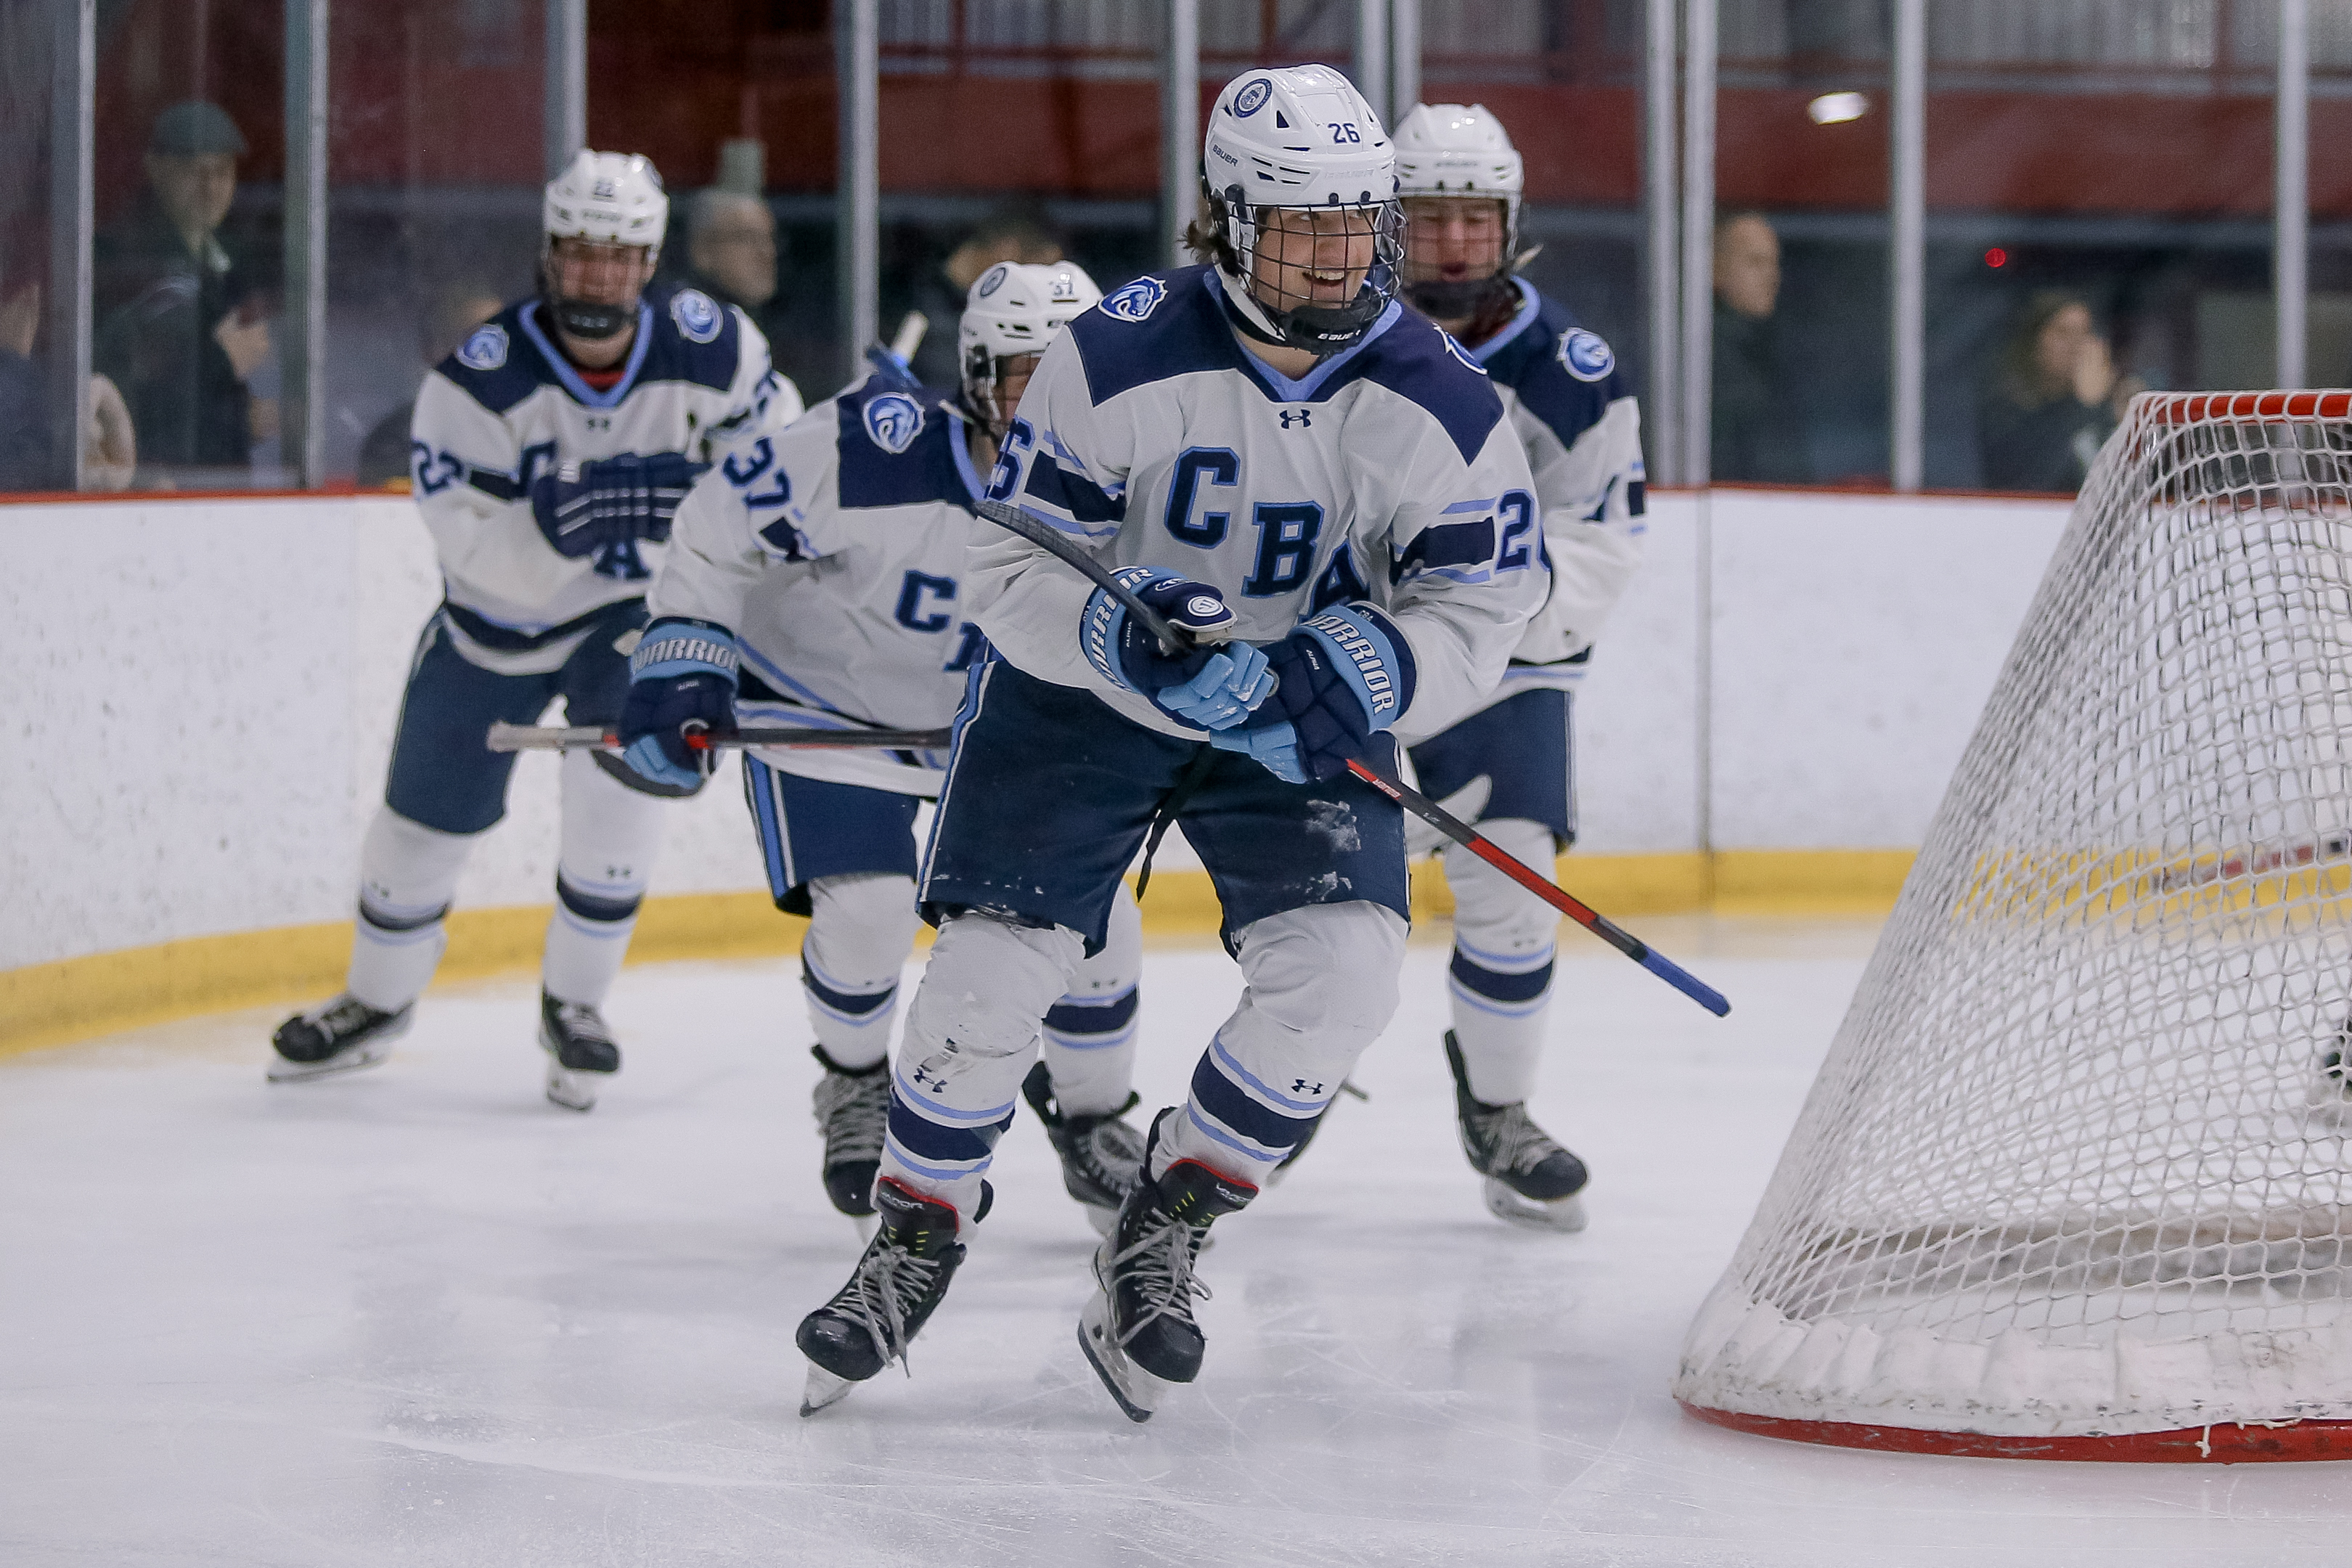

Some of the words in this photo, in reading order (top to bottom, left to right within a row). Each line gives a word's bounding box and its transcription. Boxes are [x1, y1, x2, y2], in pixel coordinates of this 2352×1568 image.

[1212, 144, 1238, 167] BAUER
[1328, 123, 1360, 144] 26
[722, 436, 792, 510] 37
[1495, 489, 1551, 573] 2
